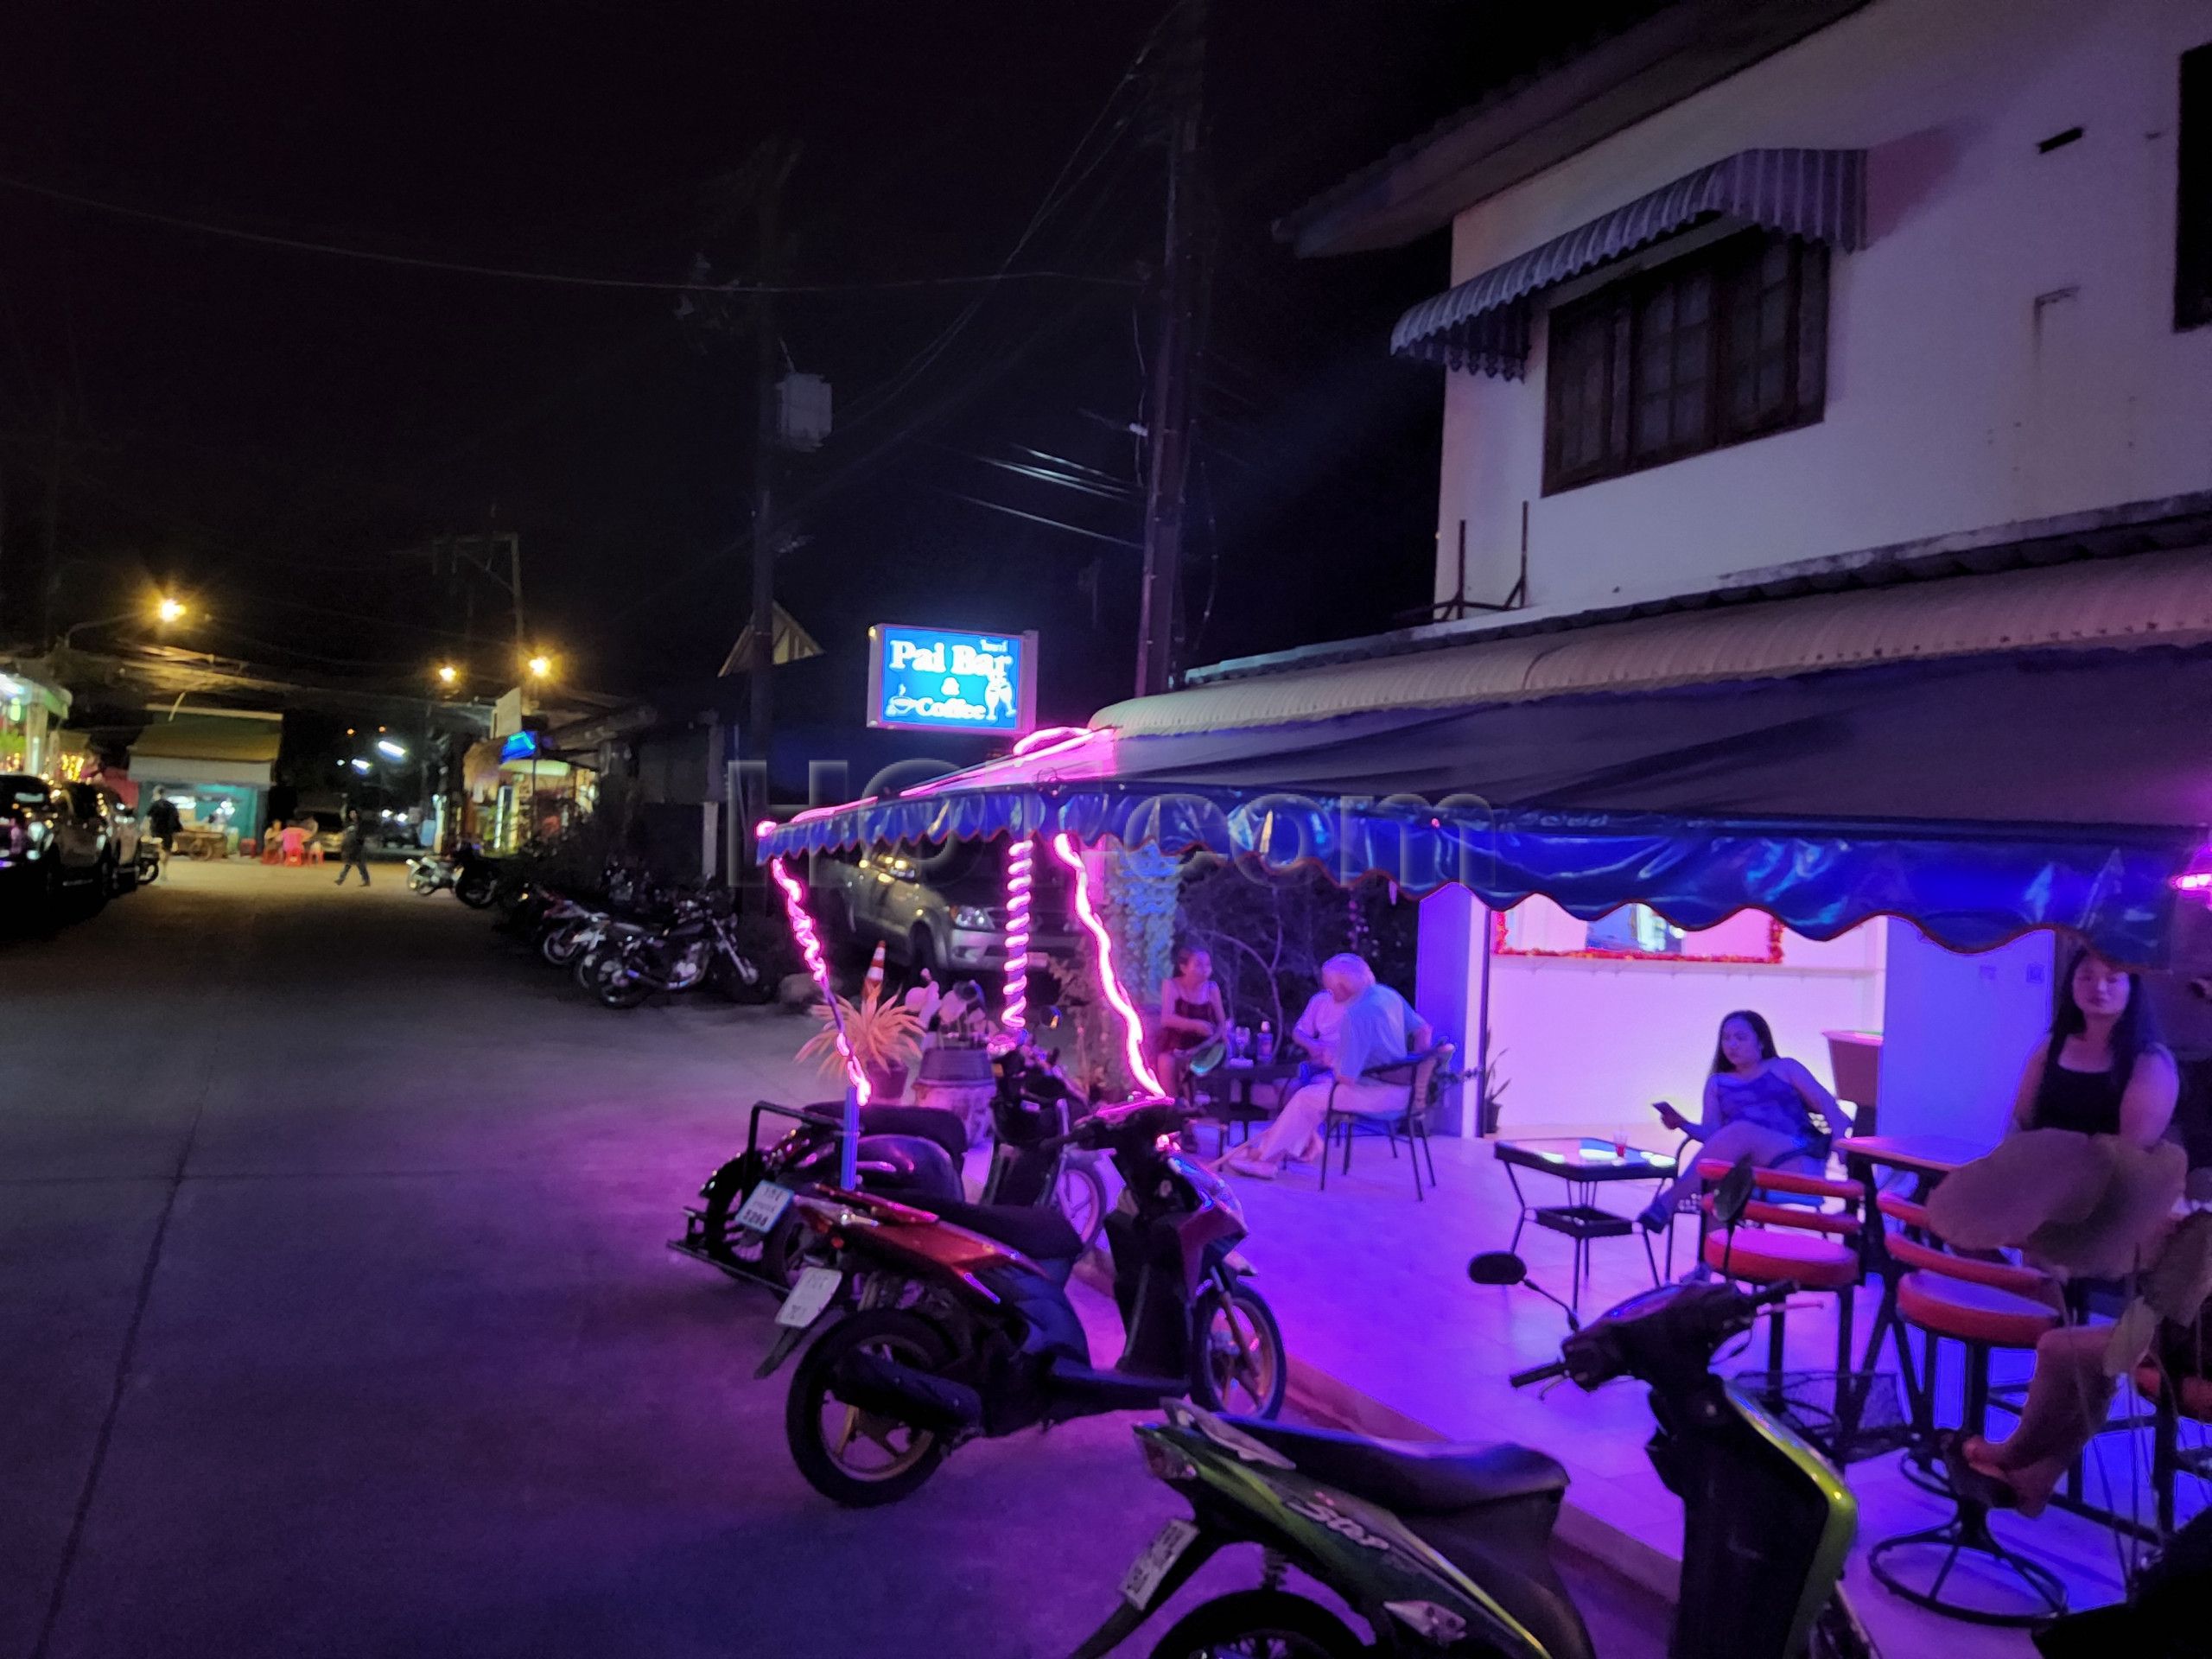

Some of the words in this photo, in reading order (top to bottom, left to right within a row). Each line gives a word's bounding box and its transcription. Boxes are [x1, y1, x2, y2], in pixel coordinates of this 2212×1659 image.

[950, 645, 1012, 676] Bar
[941, 677, 960, 696] &
[915, 697, 986, 720] Coffee
